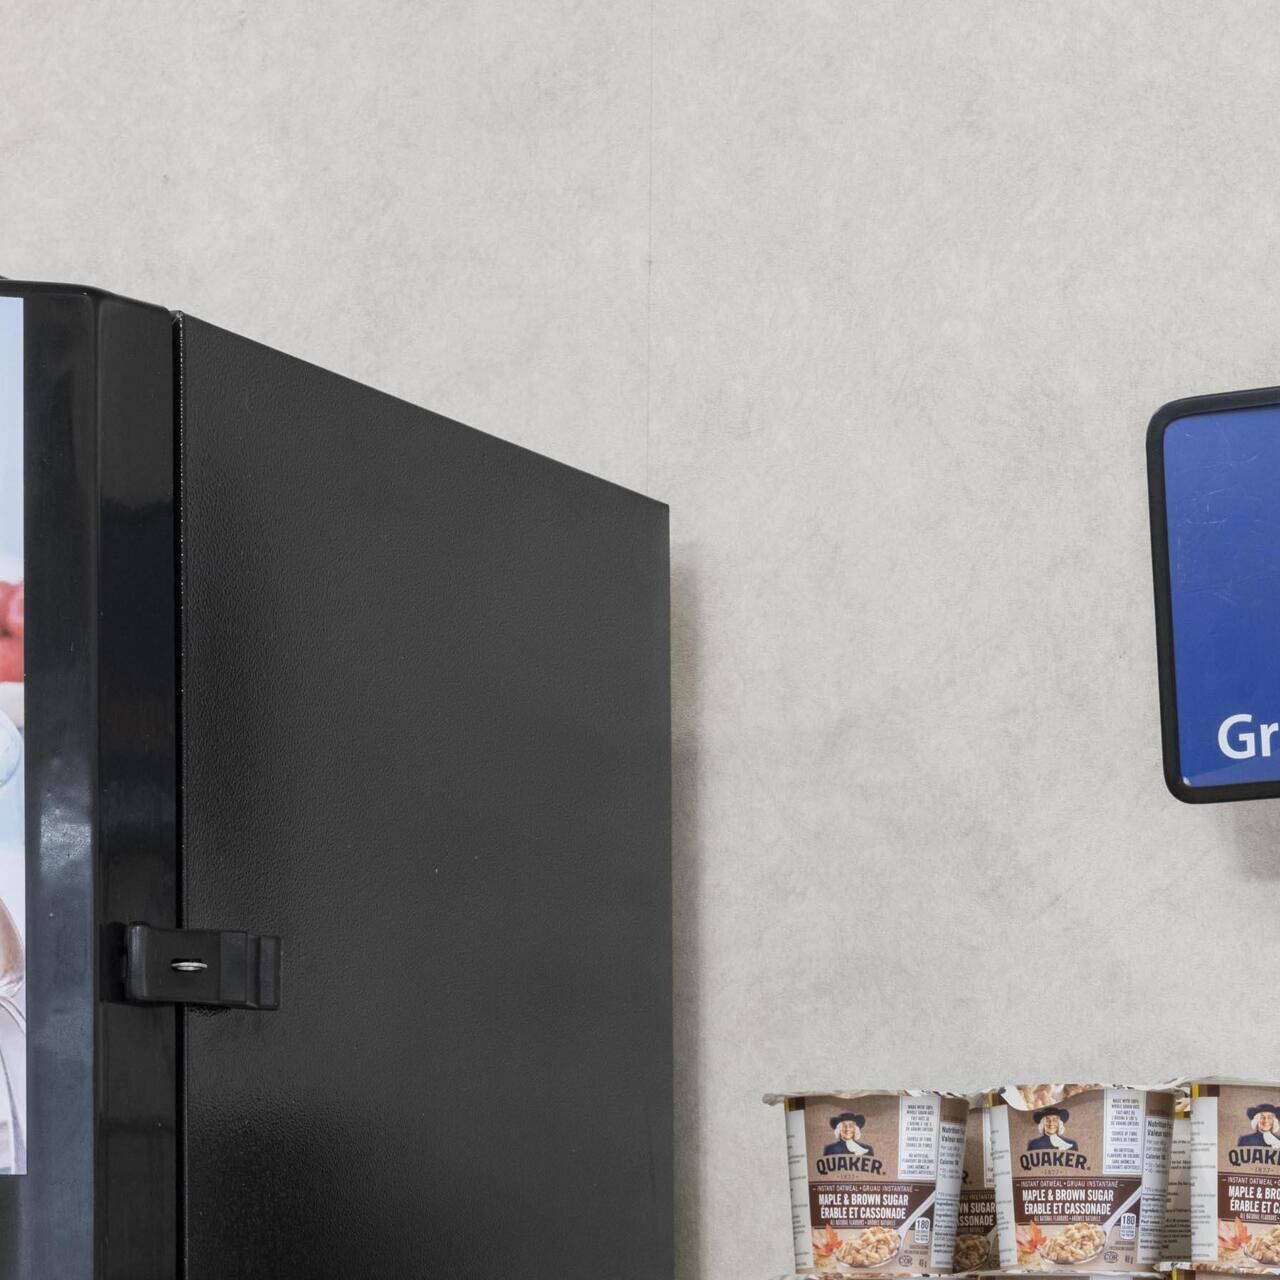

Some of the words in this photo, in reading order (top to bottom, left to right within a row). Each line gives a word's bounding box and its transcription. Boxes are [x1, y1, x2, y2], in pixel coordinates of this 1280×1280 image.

[817, 1156, 883, 1175] QUAKER
[1021, 1152, 1087, 1171] QUAKER
[1023, 1189, 1044, 1201] MAPLE
[1048, 1190, 1054, 1200] &
[1056, 1190, 1085, 1201] BROWN
[1088, 1190, 1113, 1201] SUGAR
[1229, 1186, 1252, 1198] MAPLE
[1256, 1188, 1262, 1198] &
[819, 1194, 842, 1206] MAPLE
[844, 1194, 849, 1205] &
[851, 1194, 880, 1206] BROWN
[883, 1194, 908, 1206] SUGAR
[1230, 1198, 1259, 1212] ÉRABLE
[1262, 1202, 1270, 1212] ET
[821, 1204, 847, 1219] ÉRABLE
[849, 1208, 858, 1219] ET
[860, 1207, 906, 1219] CASSONADE
[1025, 1200, 1051, 1215] ÉRABLE
[1054, 1203, 1062, 1214] ET
[1065, 1203, 1111, 1215] CASSONADE
[917, 1220, 929, 1229] 180
[1123, 1215, 1135, 1225] 180
